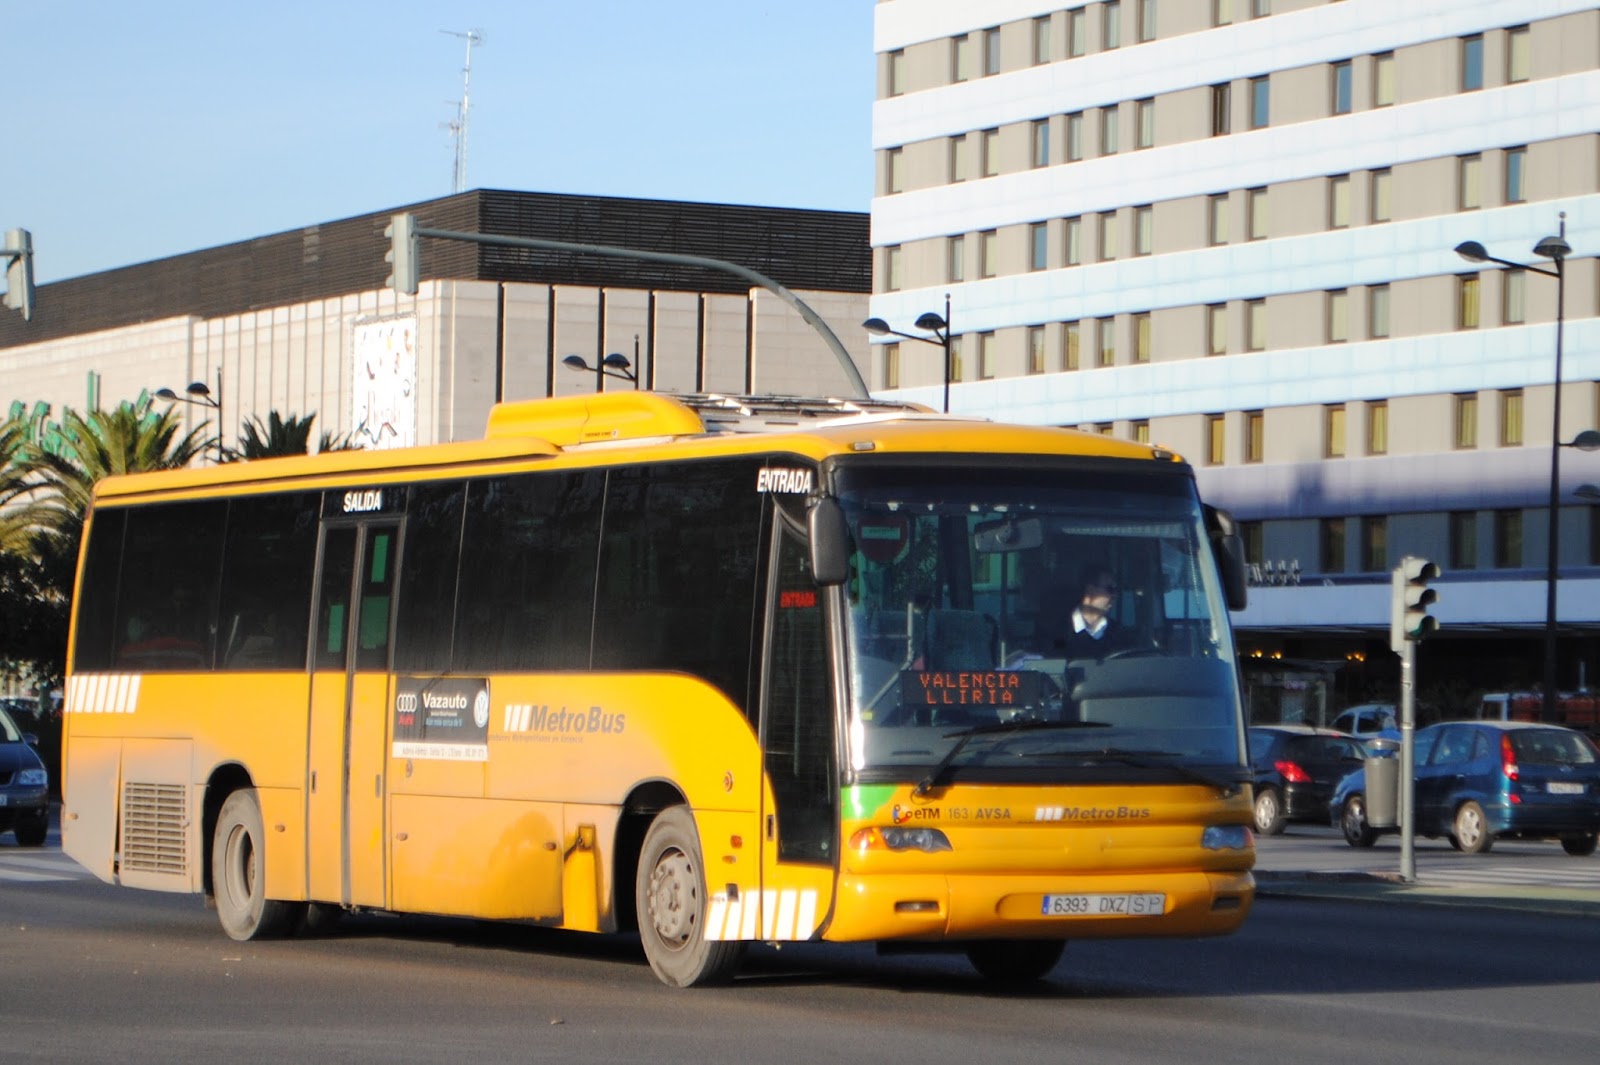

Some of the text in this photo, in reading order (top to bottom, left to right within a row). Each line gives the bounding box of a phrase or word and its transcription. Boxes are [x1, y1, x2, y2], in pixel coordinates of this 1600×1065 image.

[757, 468, 813, 493] ENTRADA
[343, 490, 382, 513] SALIDA
[780, 592, 816, 608] ENTRADA
[919, 673, 1020, 689] VALENCIA
[422, 692, 468, 709] Vazauto
[926, 689, 1013, 705] LLIRIA
[529, 705, 626, 733] MetroBus
[948, 808, 969, 819] 163
[975, 808, 1012, 820] AVSA
[1062, 806, 1150, 820] MetroBus
[1053, 897, 1161, 913] 6393 DXZ SP
